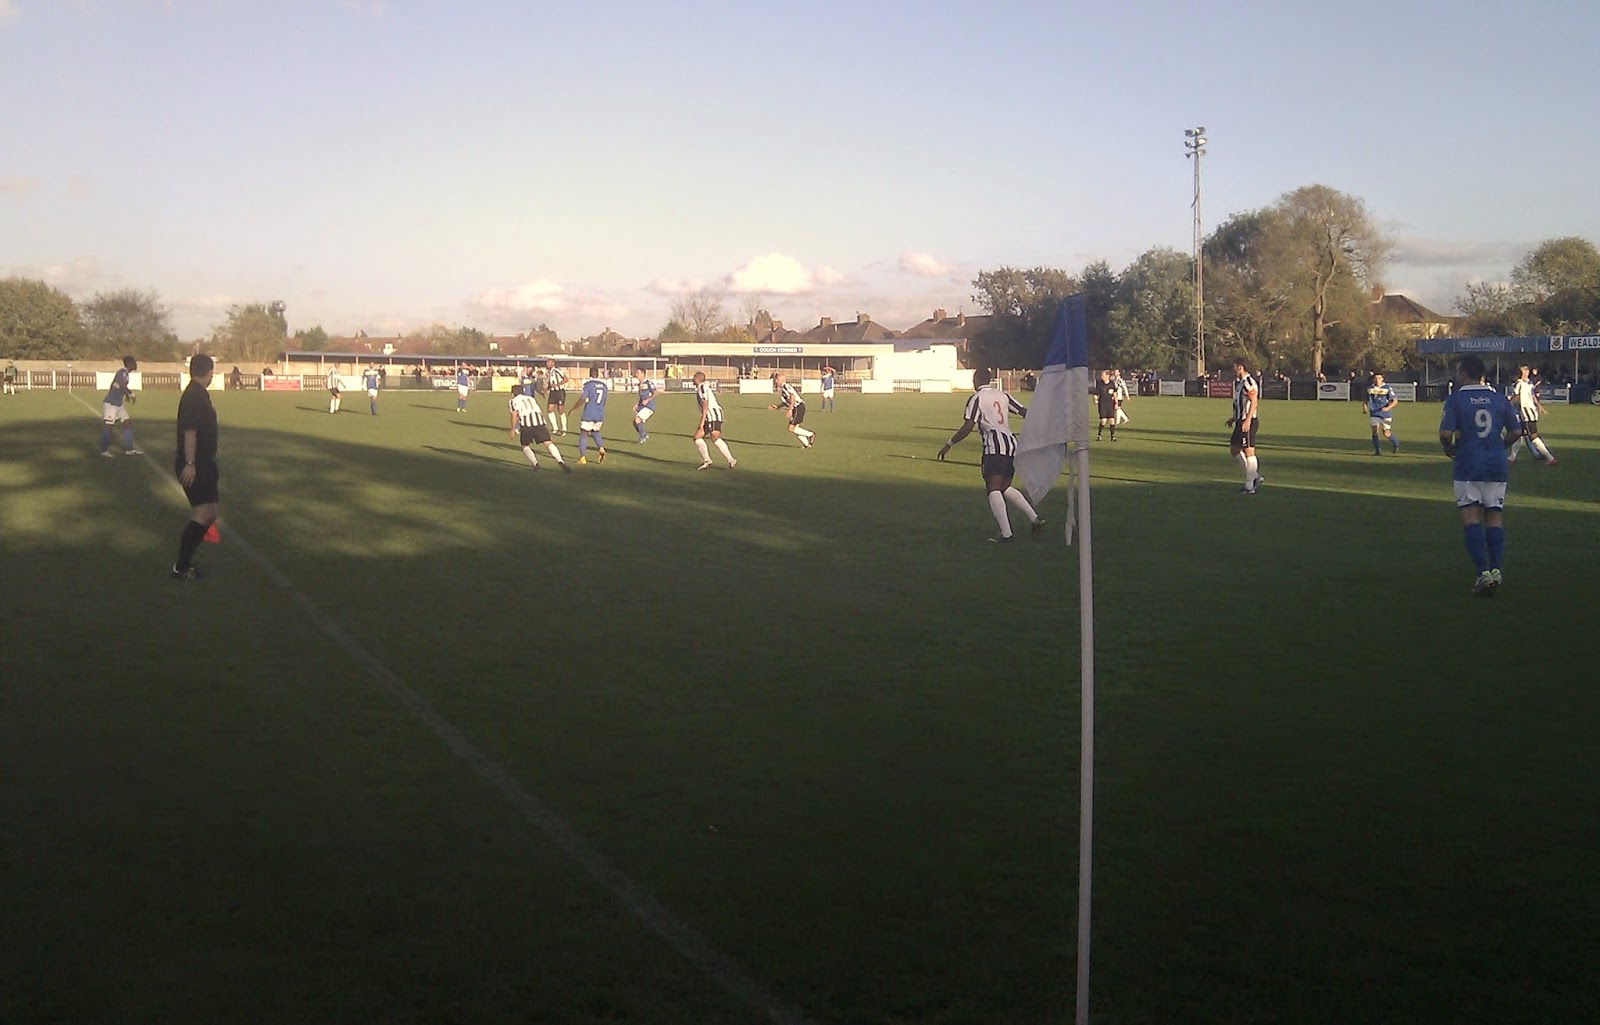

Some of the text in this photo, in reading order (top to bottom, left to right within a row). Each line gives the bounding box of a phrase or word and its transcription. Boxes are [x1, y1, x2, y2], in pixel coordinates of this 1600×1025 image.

[596, 389, 603, 403] 7
[993, 401, 1004, 424] 3
[1474, 408, 1492, 438] 9
